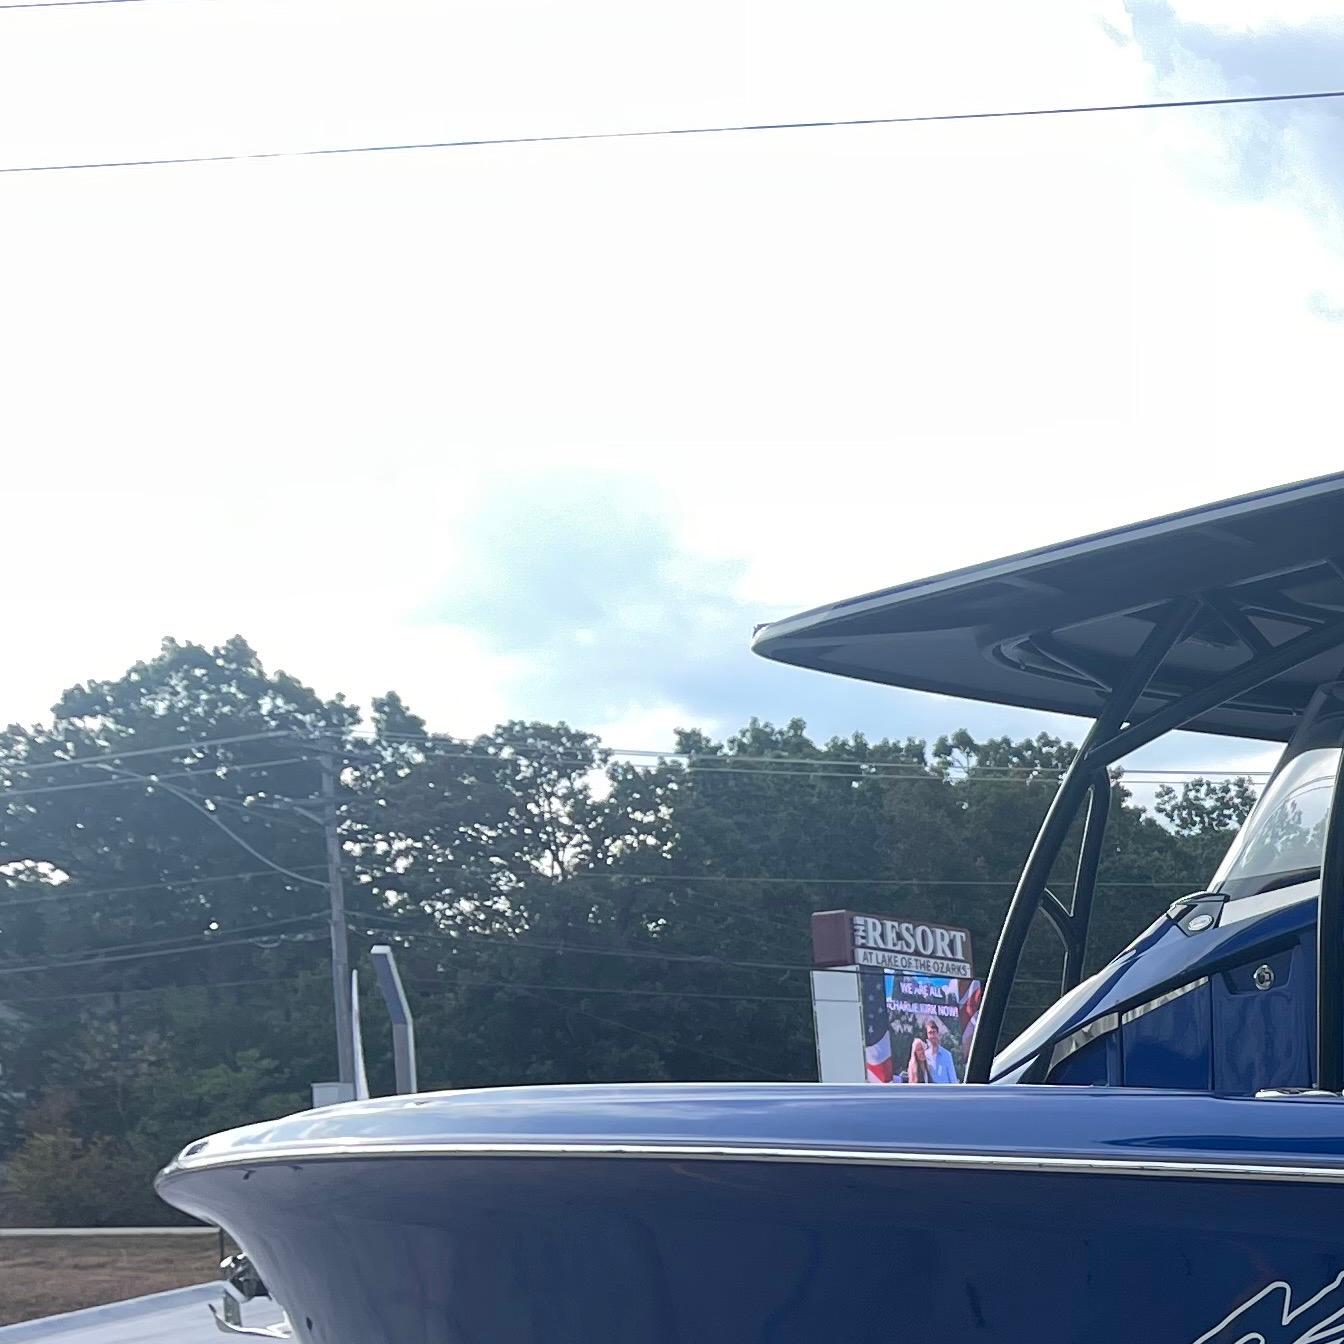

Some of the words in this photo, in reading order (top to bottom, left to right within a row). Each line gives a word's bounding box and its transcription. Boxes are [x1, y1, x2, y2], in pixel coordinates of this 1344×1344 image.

[853, 916, 866, 946] THE
[864, 917, 966, 960] RESORT
[863, 951, 874, 963] AT
[876, 953, 899, 968] LAKE
[900, 957, 913, 969] OF
[915, 959, 931, 972] THE
[932, 962, 968, 977] OZARKS
